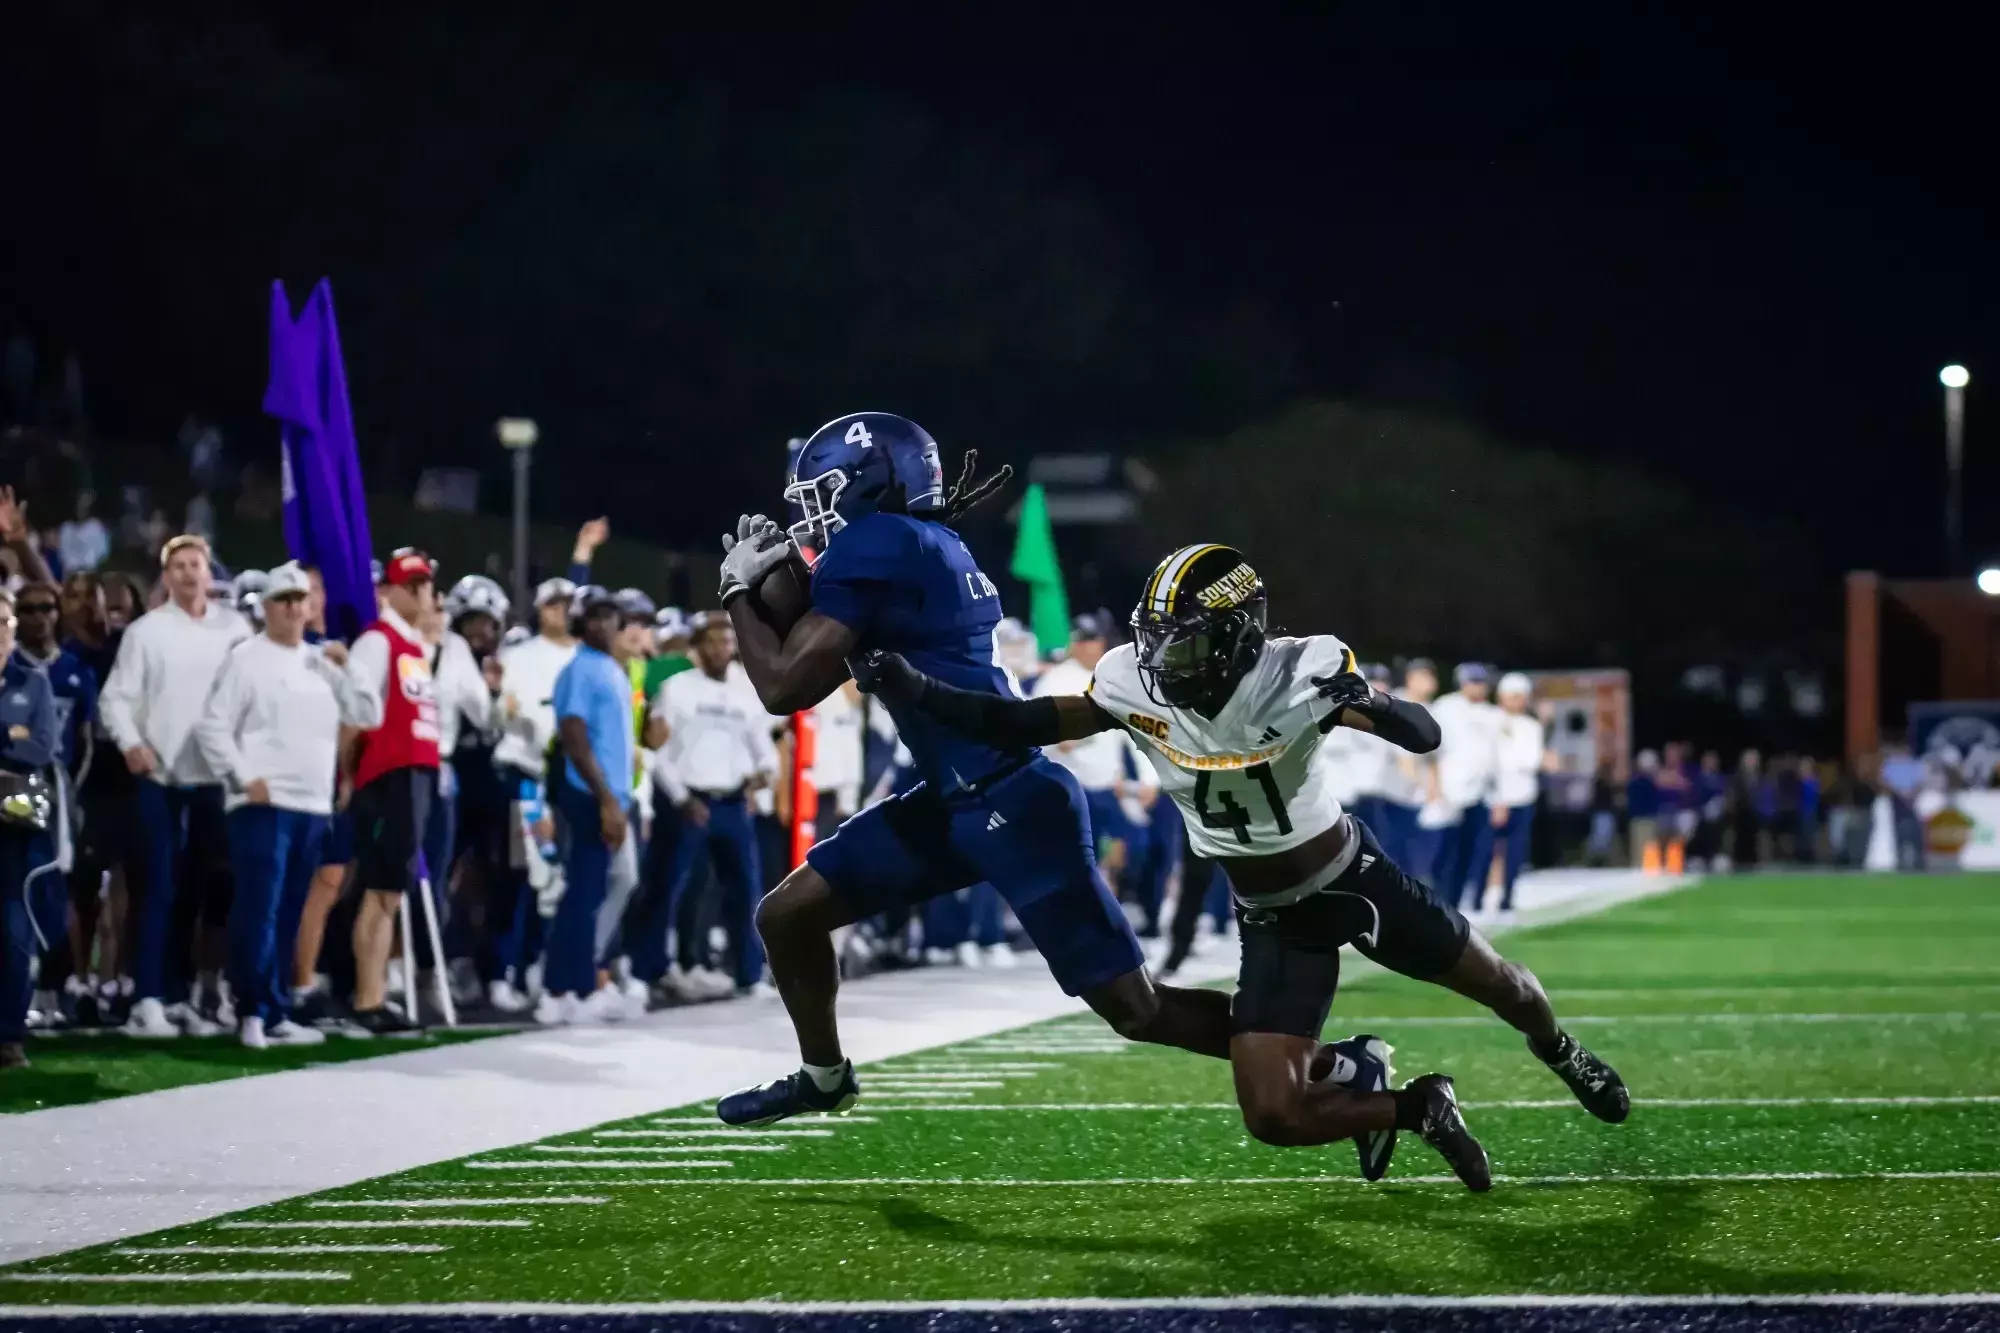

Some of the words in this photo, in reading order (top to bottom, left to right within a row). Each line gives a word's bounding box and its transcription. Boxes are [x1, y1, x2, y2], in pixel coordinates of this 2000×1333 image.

[844, 421, 873, 449] 4
[965, 572, 983, 600] C.
[1196, 562, 1257, 607] SOUTHERN
[1193, 761, 1293, 845] 41
